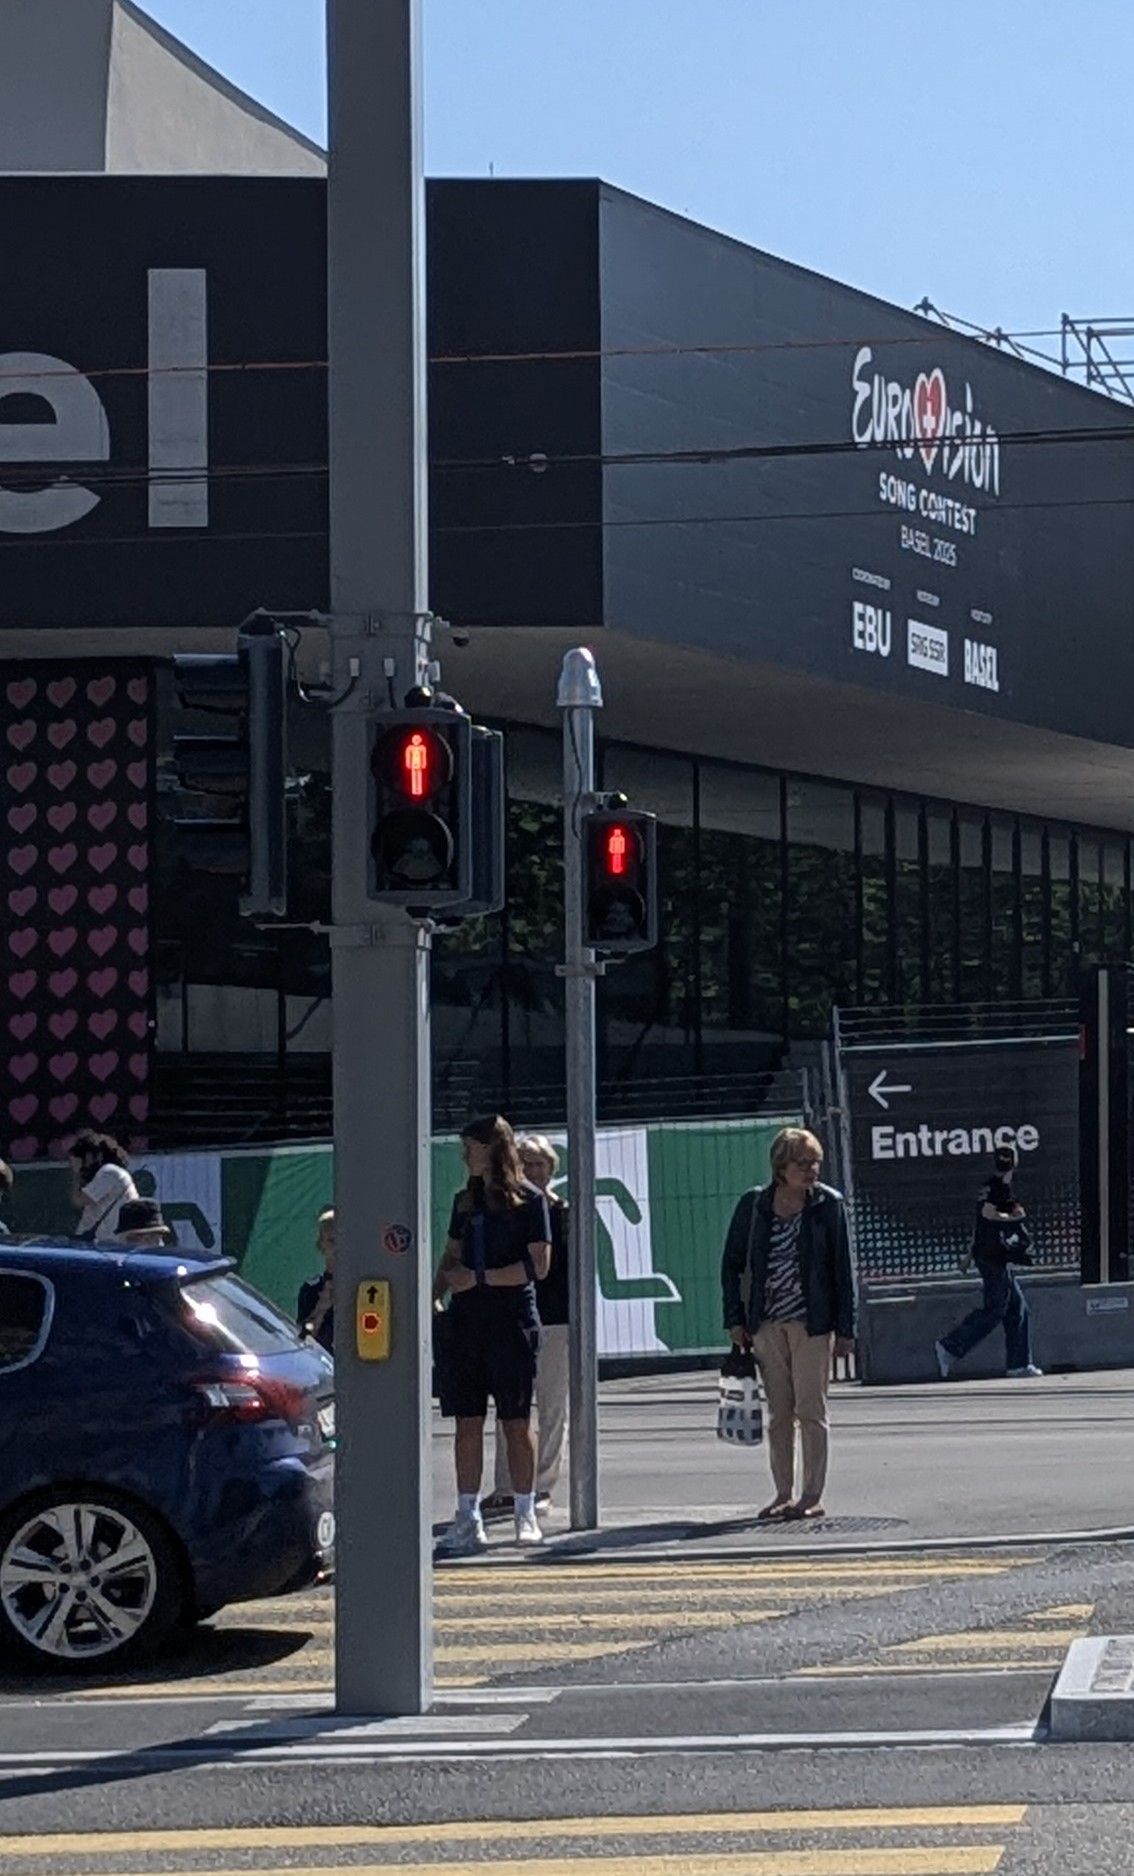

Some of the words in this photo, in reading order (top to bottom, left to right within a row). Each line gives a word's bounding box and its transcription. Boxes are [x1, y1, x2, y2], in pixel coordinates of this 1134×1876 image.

[879, 471, 916, 512] SONG
[919, 488, 976, 536] CONTEST
[901, 524, 931, 559] BASEL
[933, 537, 957, 567] 2025
[852, 600, 892, 658] EBU
[964, 638, 1000, 693] BASEL
[871, 1123, 1040, 1160] Entrance
